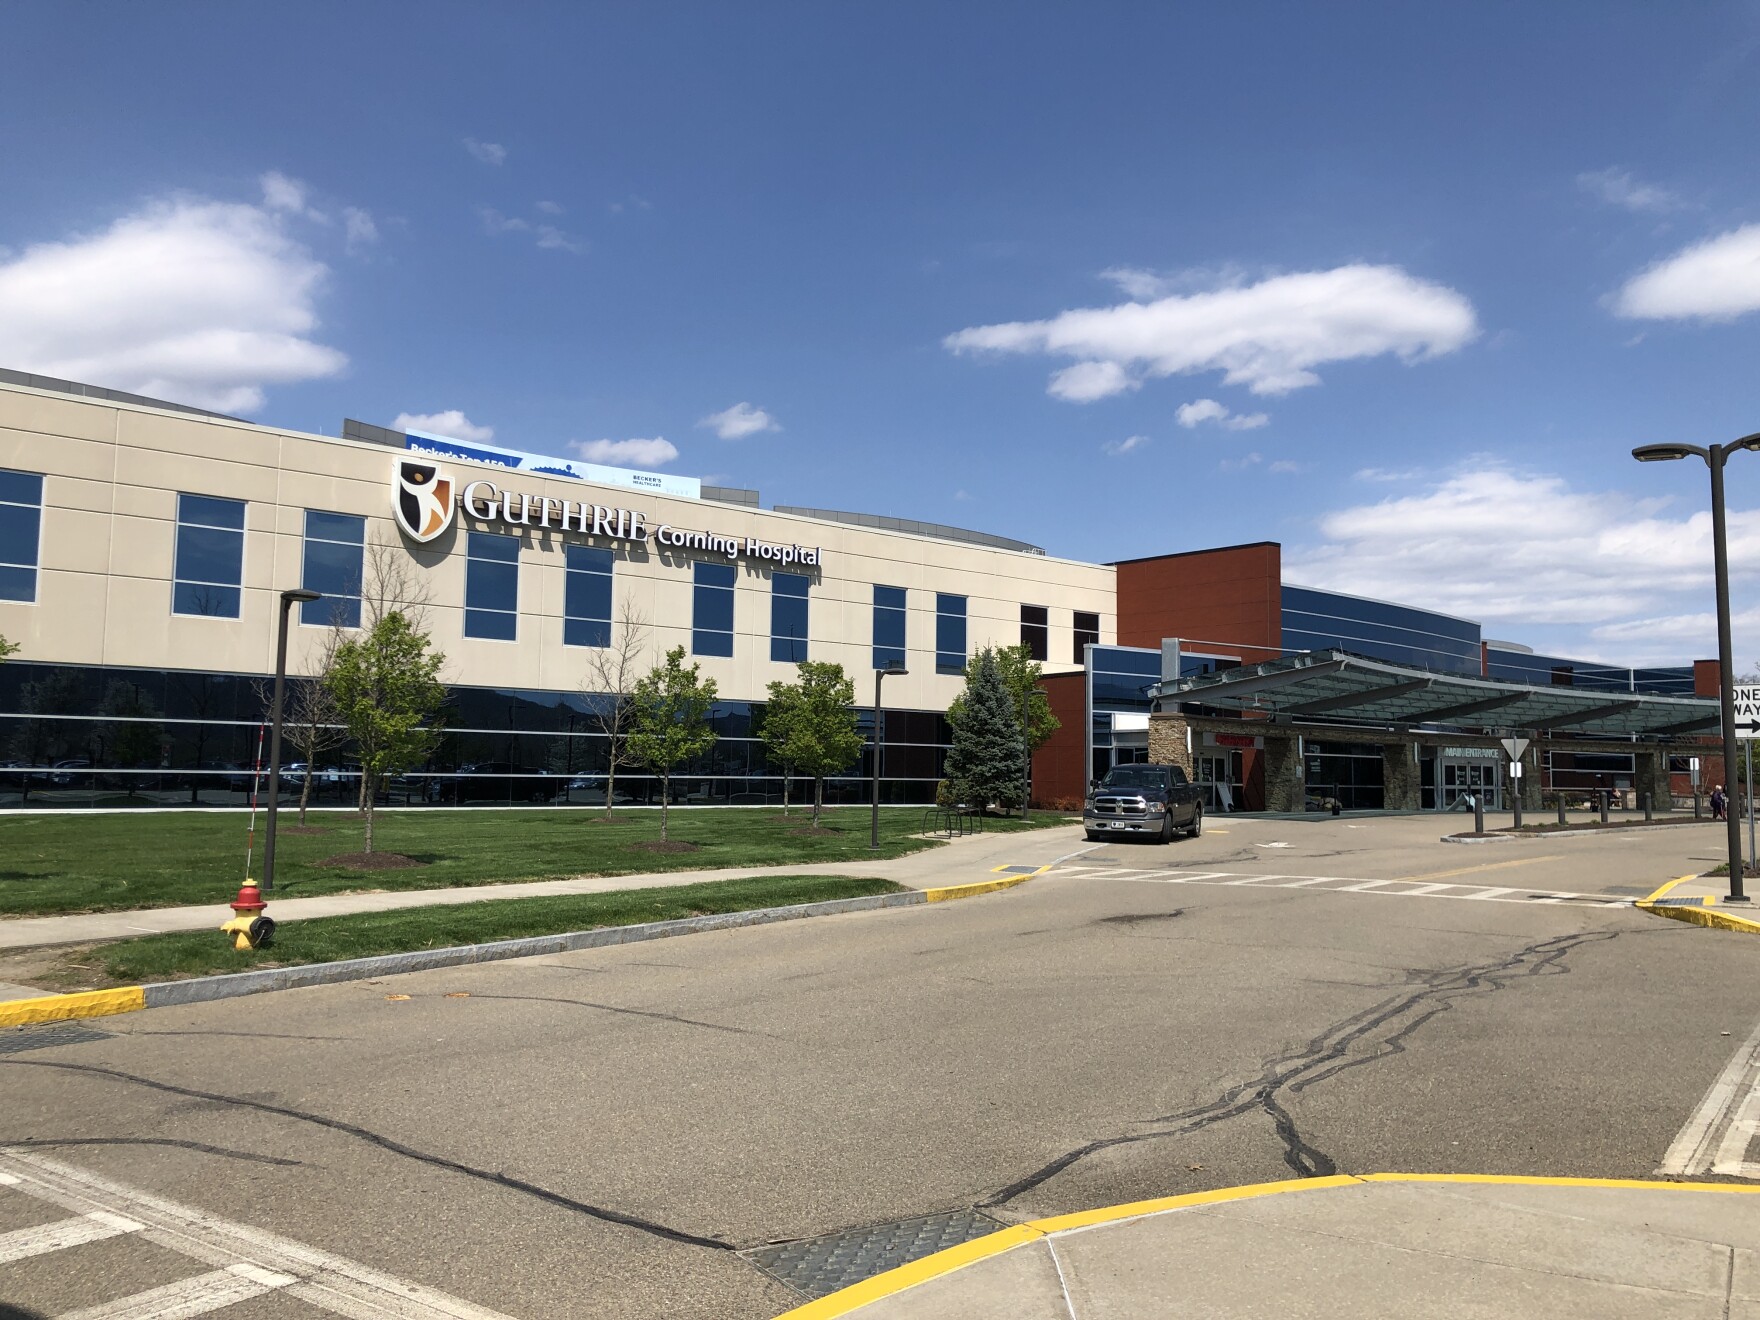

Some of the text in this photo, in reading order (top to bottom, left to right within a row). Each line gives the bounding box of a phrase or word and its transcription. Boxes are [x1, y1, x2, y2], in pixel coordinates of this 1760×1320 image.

[632, 475, 662, 484] BECKER'S
[632, 480, 662, 488] HEALTHCARE
[463, 481, 822, 566] GUTHRIE Corning Hospital
[1444, 747, 1499, 759] MAIN ENTRANCE
